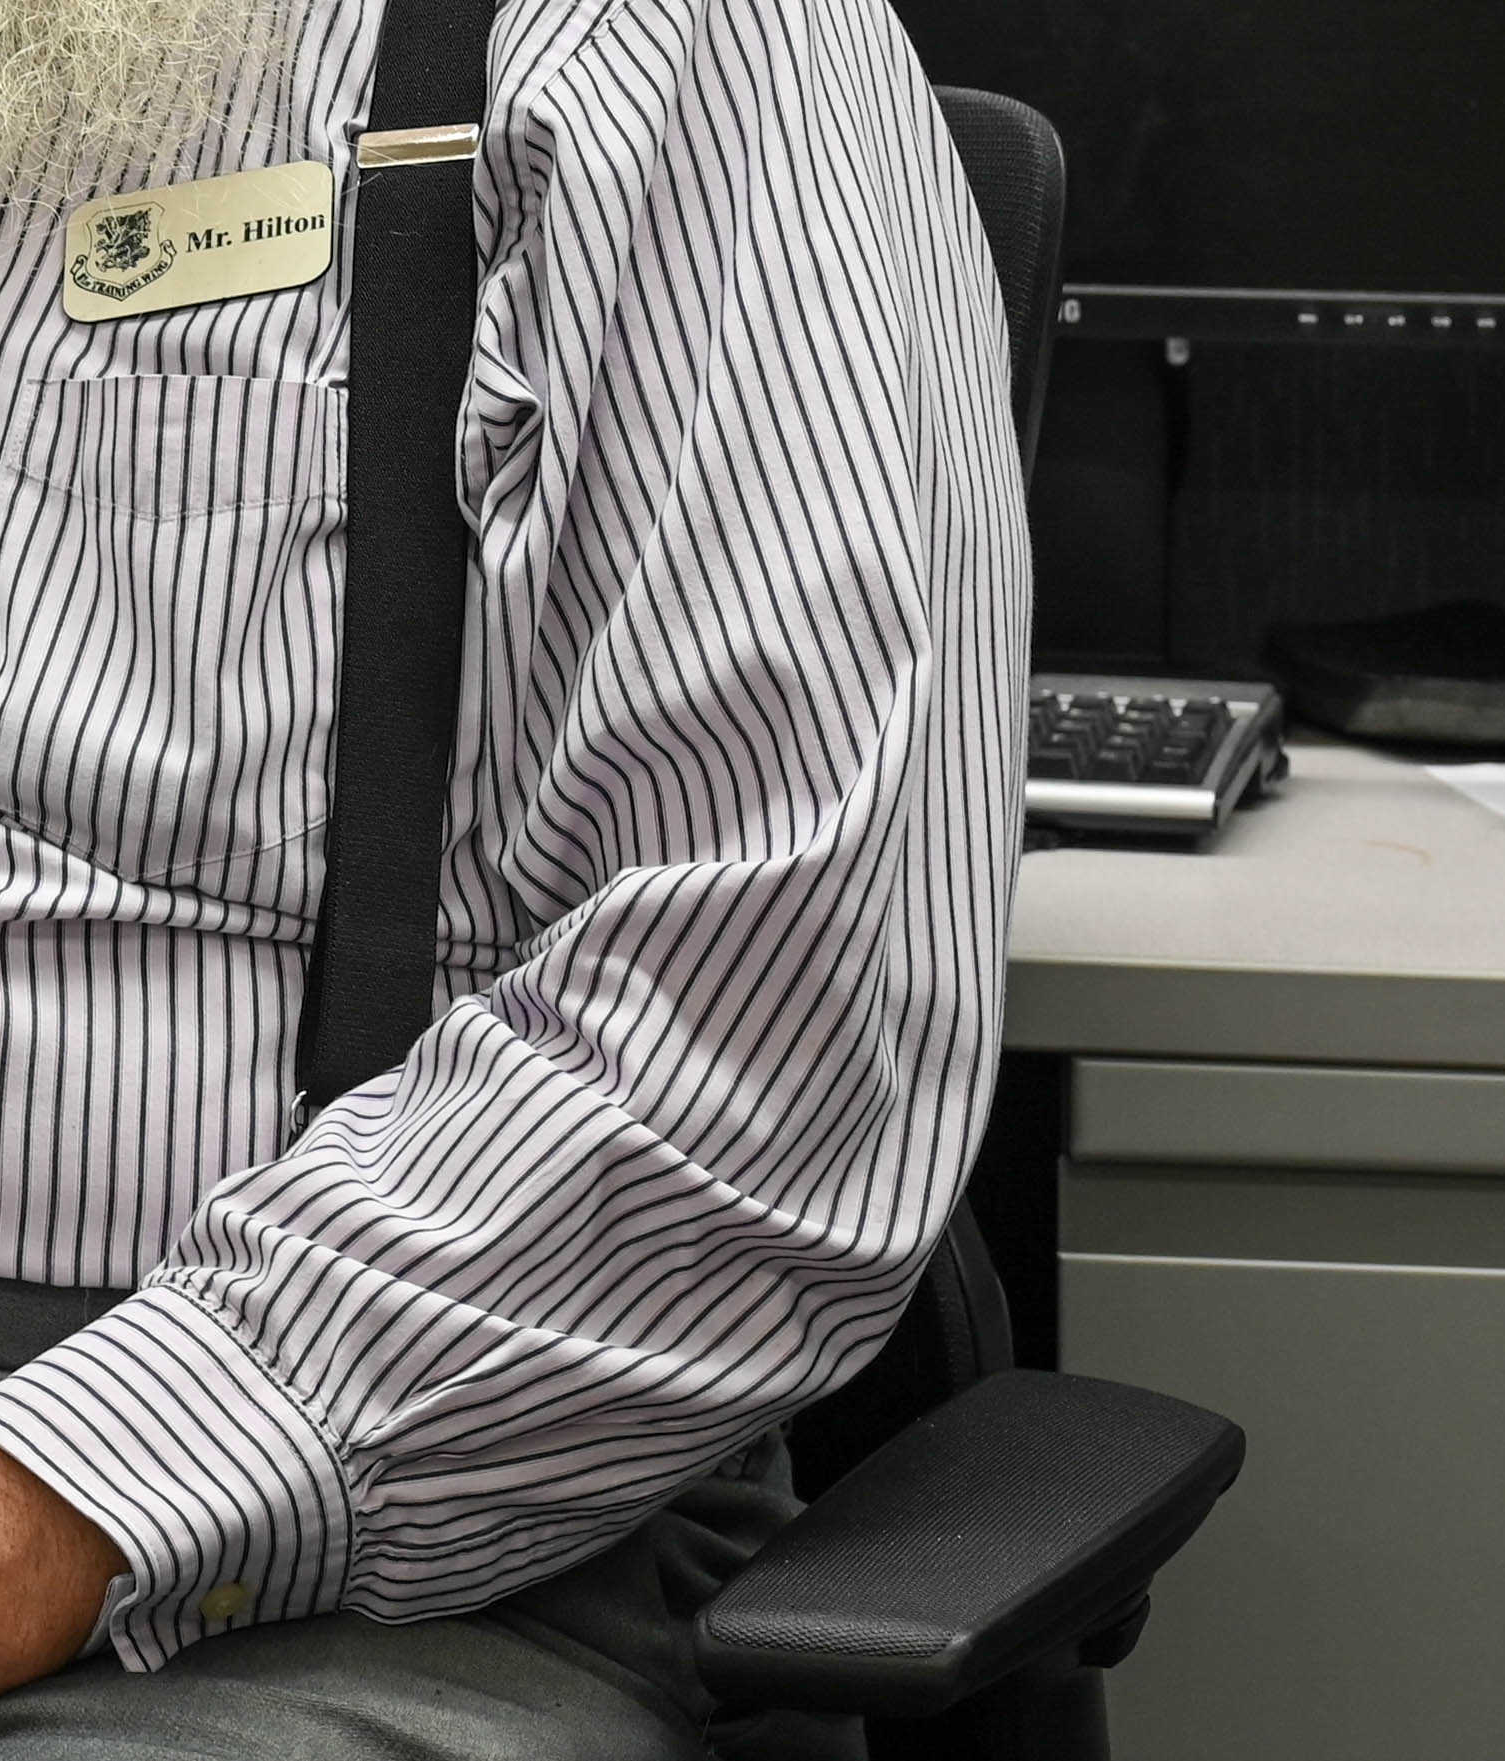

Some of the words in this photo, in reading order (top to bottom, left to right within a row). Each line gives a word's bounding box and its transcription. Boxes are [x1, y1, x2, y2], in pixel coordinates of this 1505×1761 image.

[186, 228, 233, 253] Mr.
[241, 214, 325, 244] Hilton
[92, 279, 141, 297] TRAINING
[142, 260, 169, 283] WING
